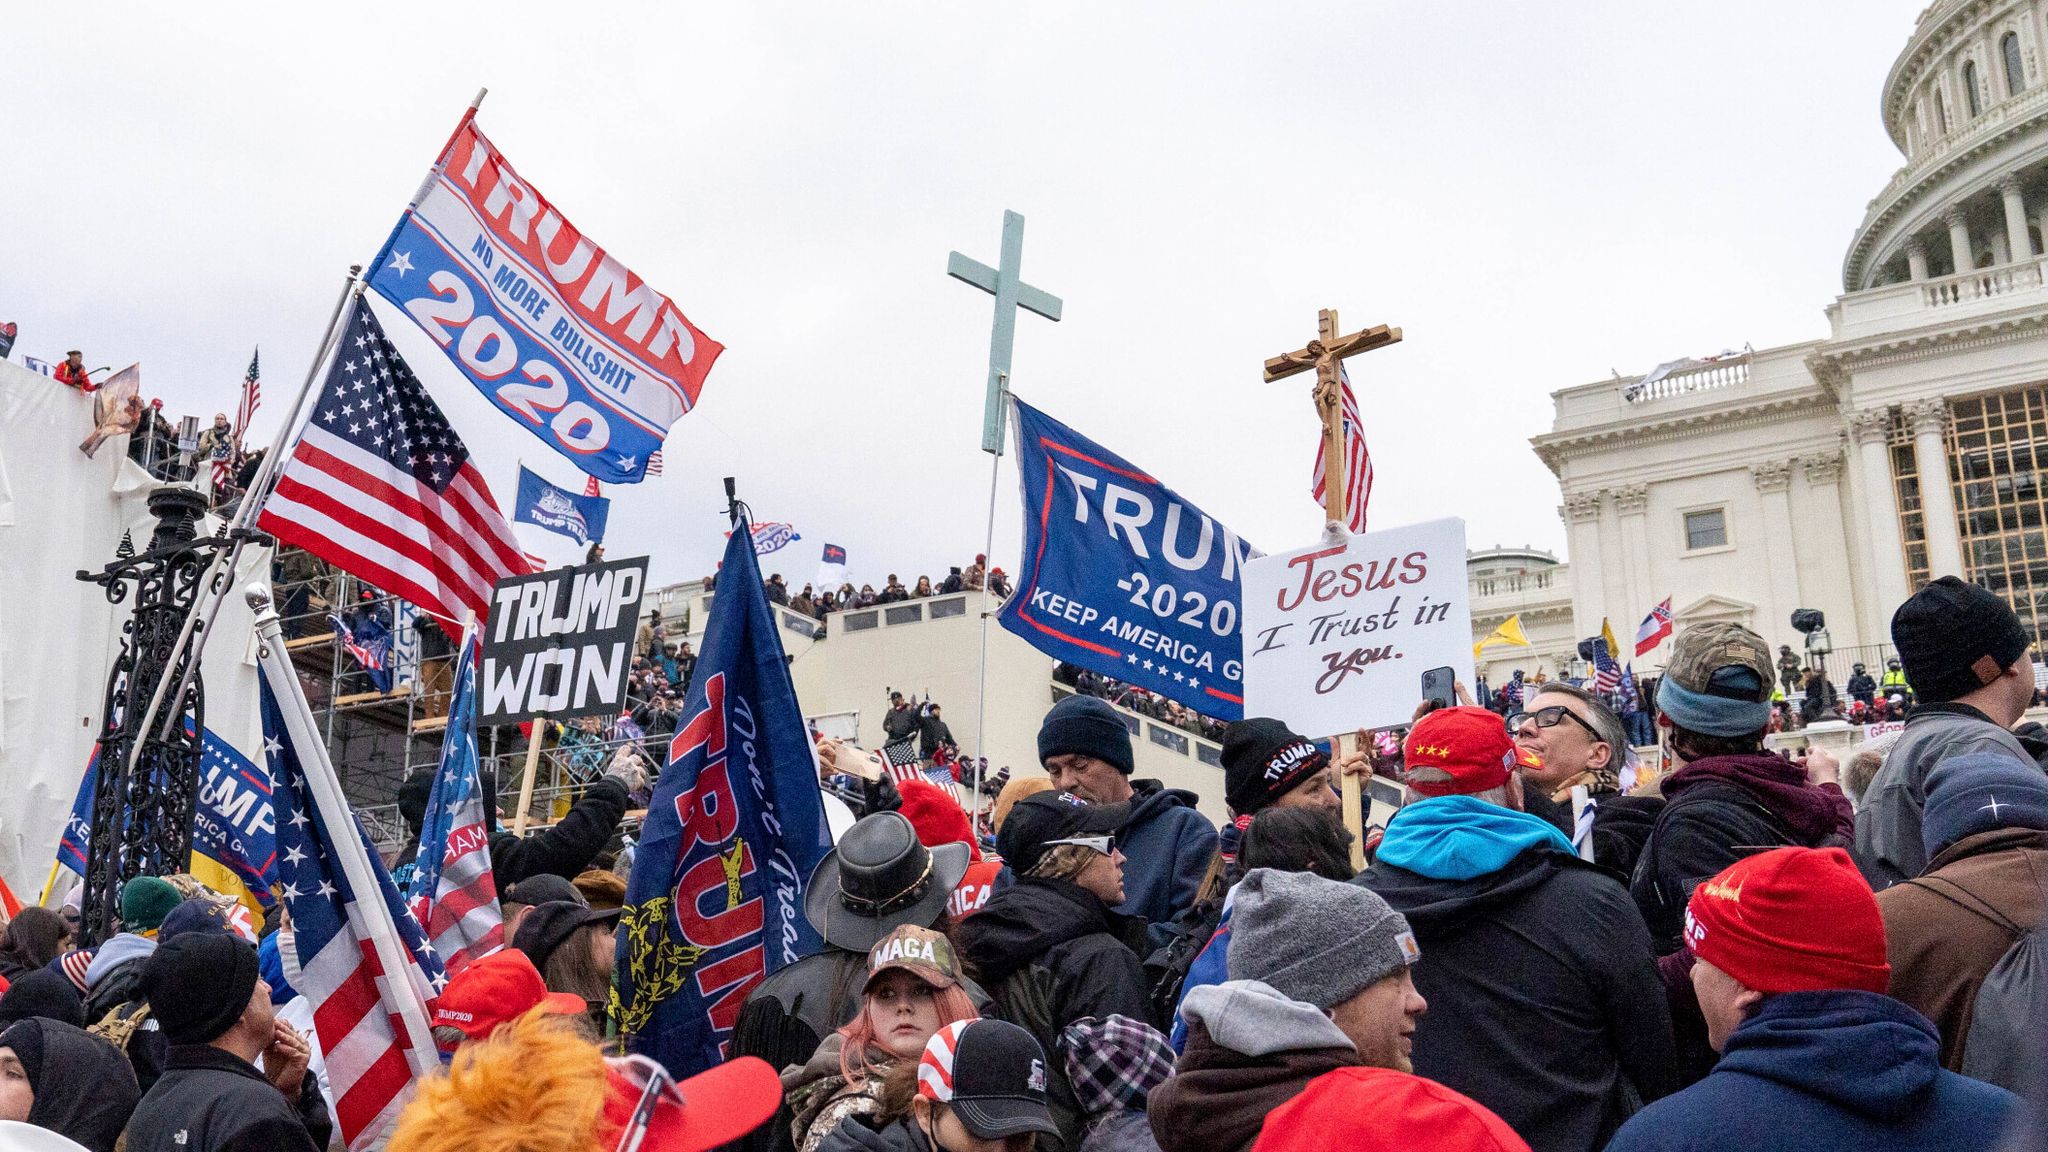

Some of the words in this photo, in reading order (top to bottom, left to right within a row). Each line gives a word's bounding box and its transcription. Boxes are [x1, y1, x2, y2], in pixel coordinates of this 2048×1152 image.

[461, 139, 695, 366] TRUMP
[471, 233, 494, 268] NO
[493, 263, 551, 322] MORE
[549, 316, 637, 396] BULLSHIT
[403, 270, 612, 454] 2020
[531, 509, 566, 528] TRUMP
[494, 566, 642, 643] TRUMP
[1277, 545, 1428, 612] Jesus
[1031, 587, 1099, 626] KEEP
[1100, 616, 1214, 673] AMERICA
[1253, 622, 1294, 657] I
[1308, 596, 1401, 646] Trust
[1413, 596, 1451, 626] in
[483, 642, 626, 716] WON
[1315, 645, 1403, 695] you.
[736, 695, 782, 837] Don't
[1263, 743, 1316, 780] TRUMP
[874, 937, 936, 969] MAGA
